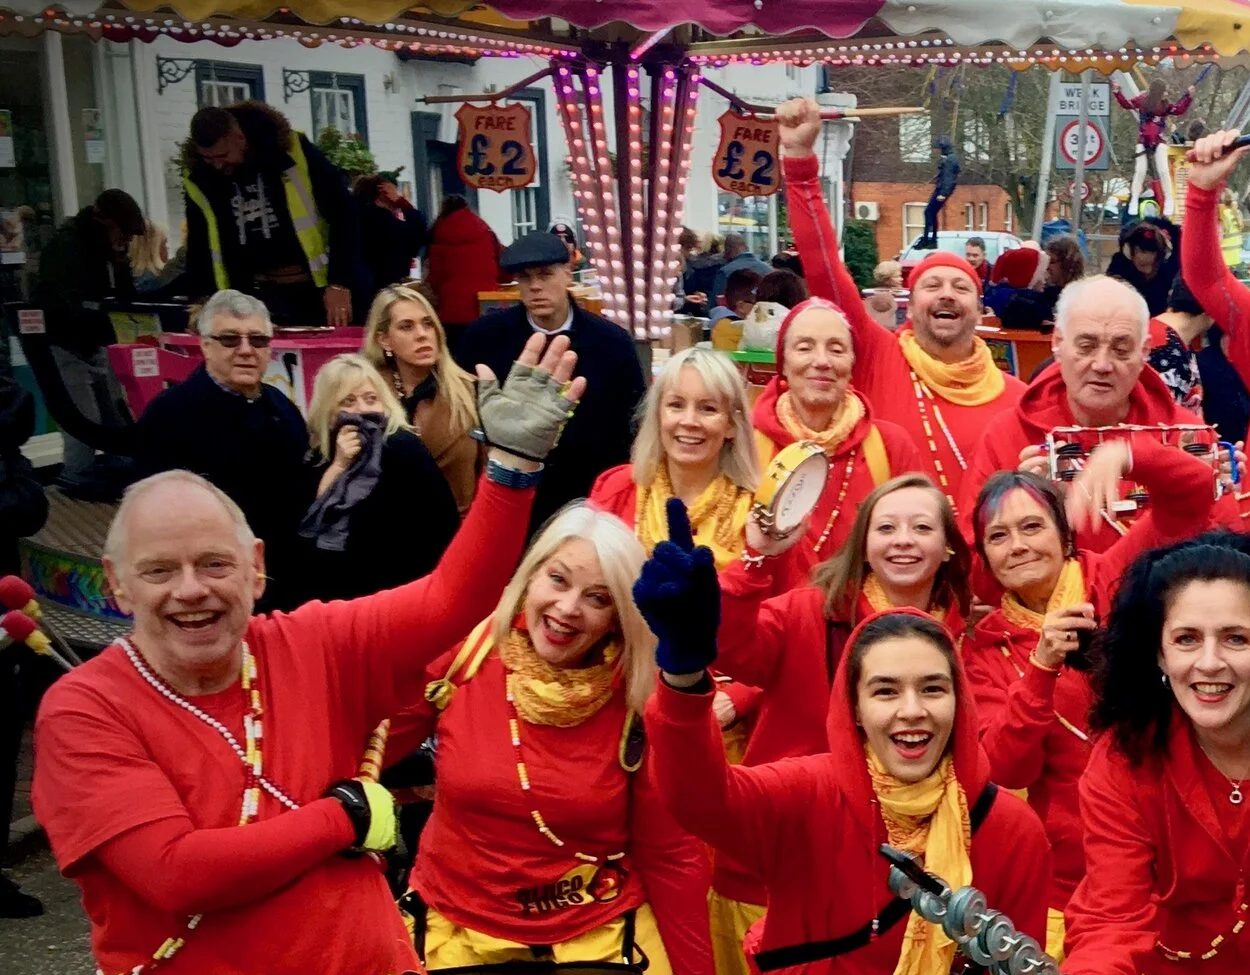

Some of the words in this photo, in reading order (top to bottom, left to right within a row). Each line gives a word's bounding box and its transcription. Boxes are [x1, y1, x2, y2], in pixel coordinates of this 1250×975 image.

[1064, 88, 1100, 98] WEK
[1060, 100, 1105, 110] BRIGE
[474, 115, 516, 130] FARE
[734, 127, 772, 143] FARE
[478, 175, 514, 186] each
[730, 181, 762, 193] each
